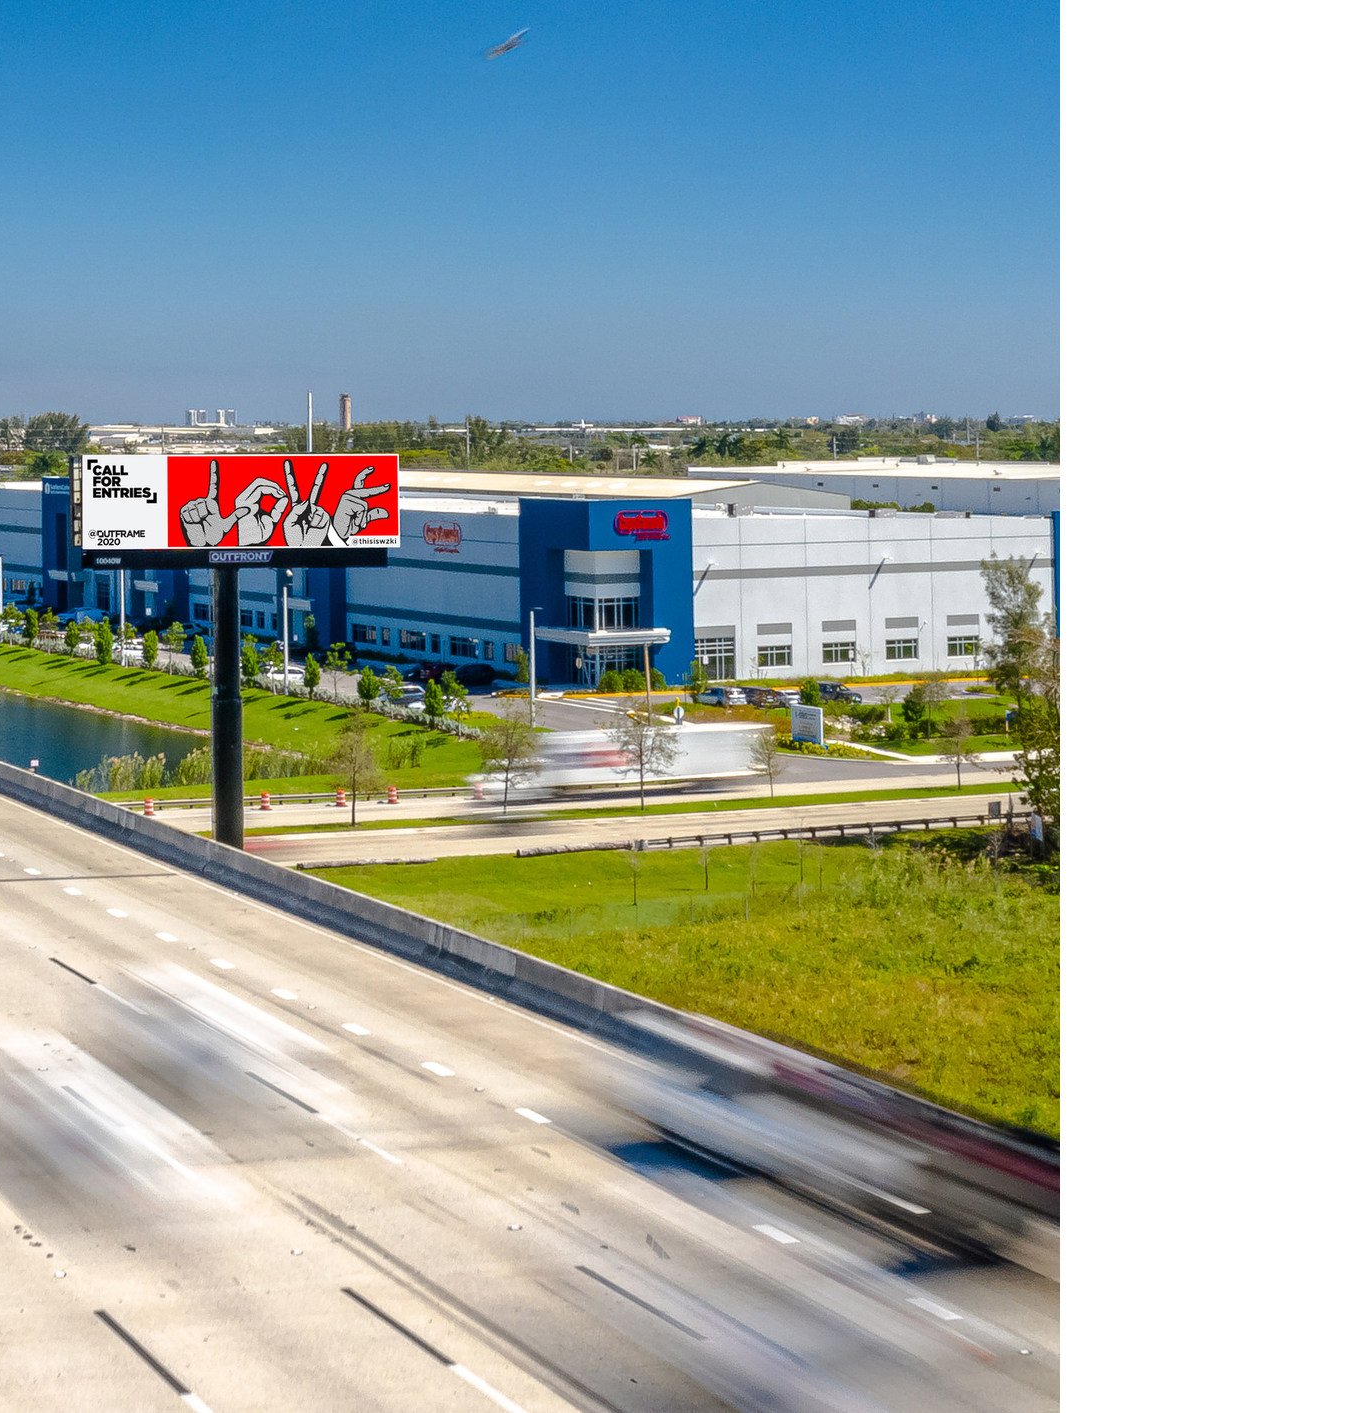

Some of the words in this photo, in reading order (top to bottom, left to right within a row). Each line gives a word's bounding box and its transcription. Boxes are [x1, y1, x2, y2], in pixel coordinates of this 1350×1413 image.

[92, 465, 129, 476] CALL
[92, 476, 121, 487] FOR
[92, 487, 152, 499] ENTRIES
[97, 538, 121, 546] 2020
[352, 538, 397, 546] @thisiswzki
[211, 552, 270, 561] OUTFRONT
